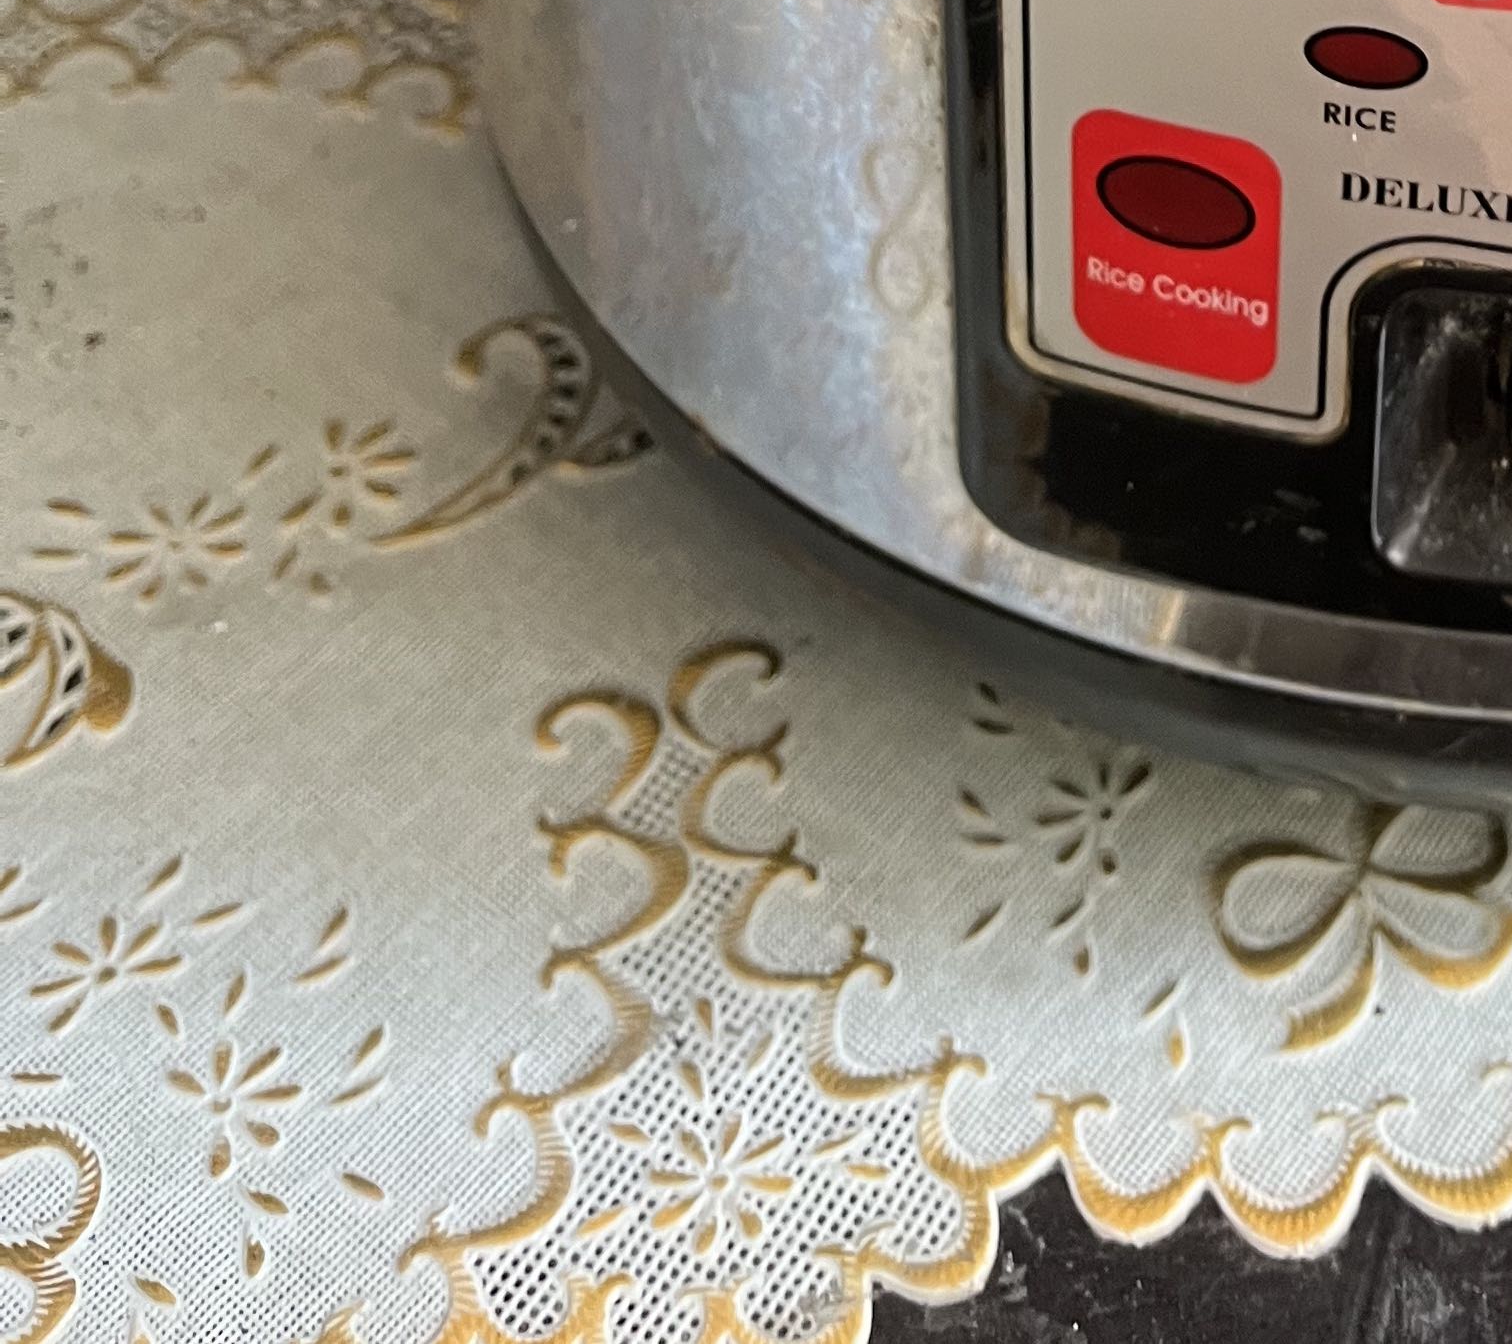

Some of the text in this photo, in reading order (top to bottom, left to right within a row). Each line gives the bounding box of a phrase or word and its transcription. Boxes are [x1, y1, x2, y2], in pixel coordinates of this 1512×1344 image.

[1323, 101, 1397, 133] RICE
[1087, 256, 1270, 327] Rice Cooking
